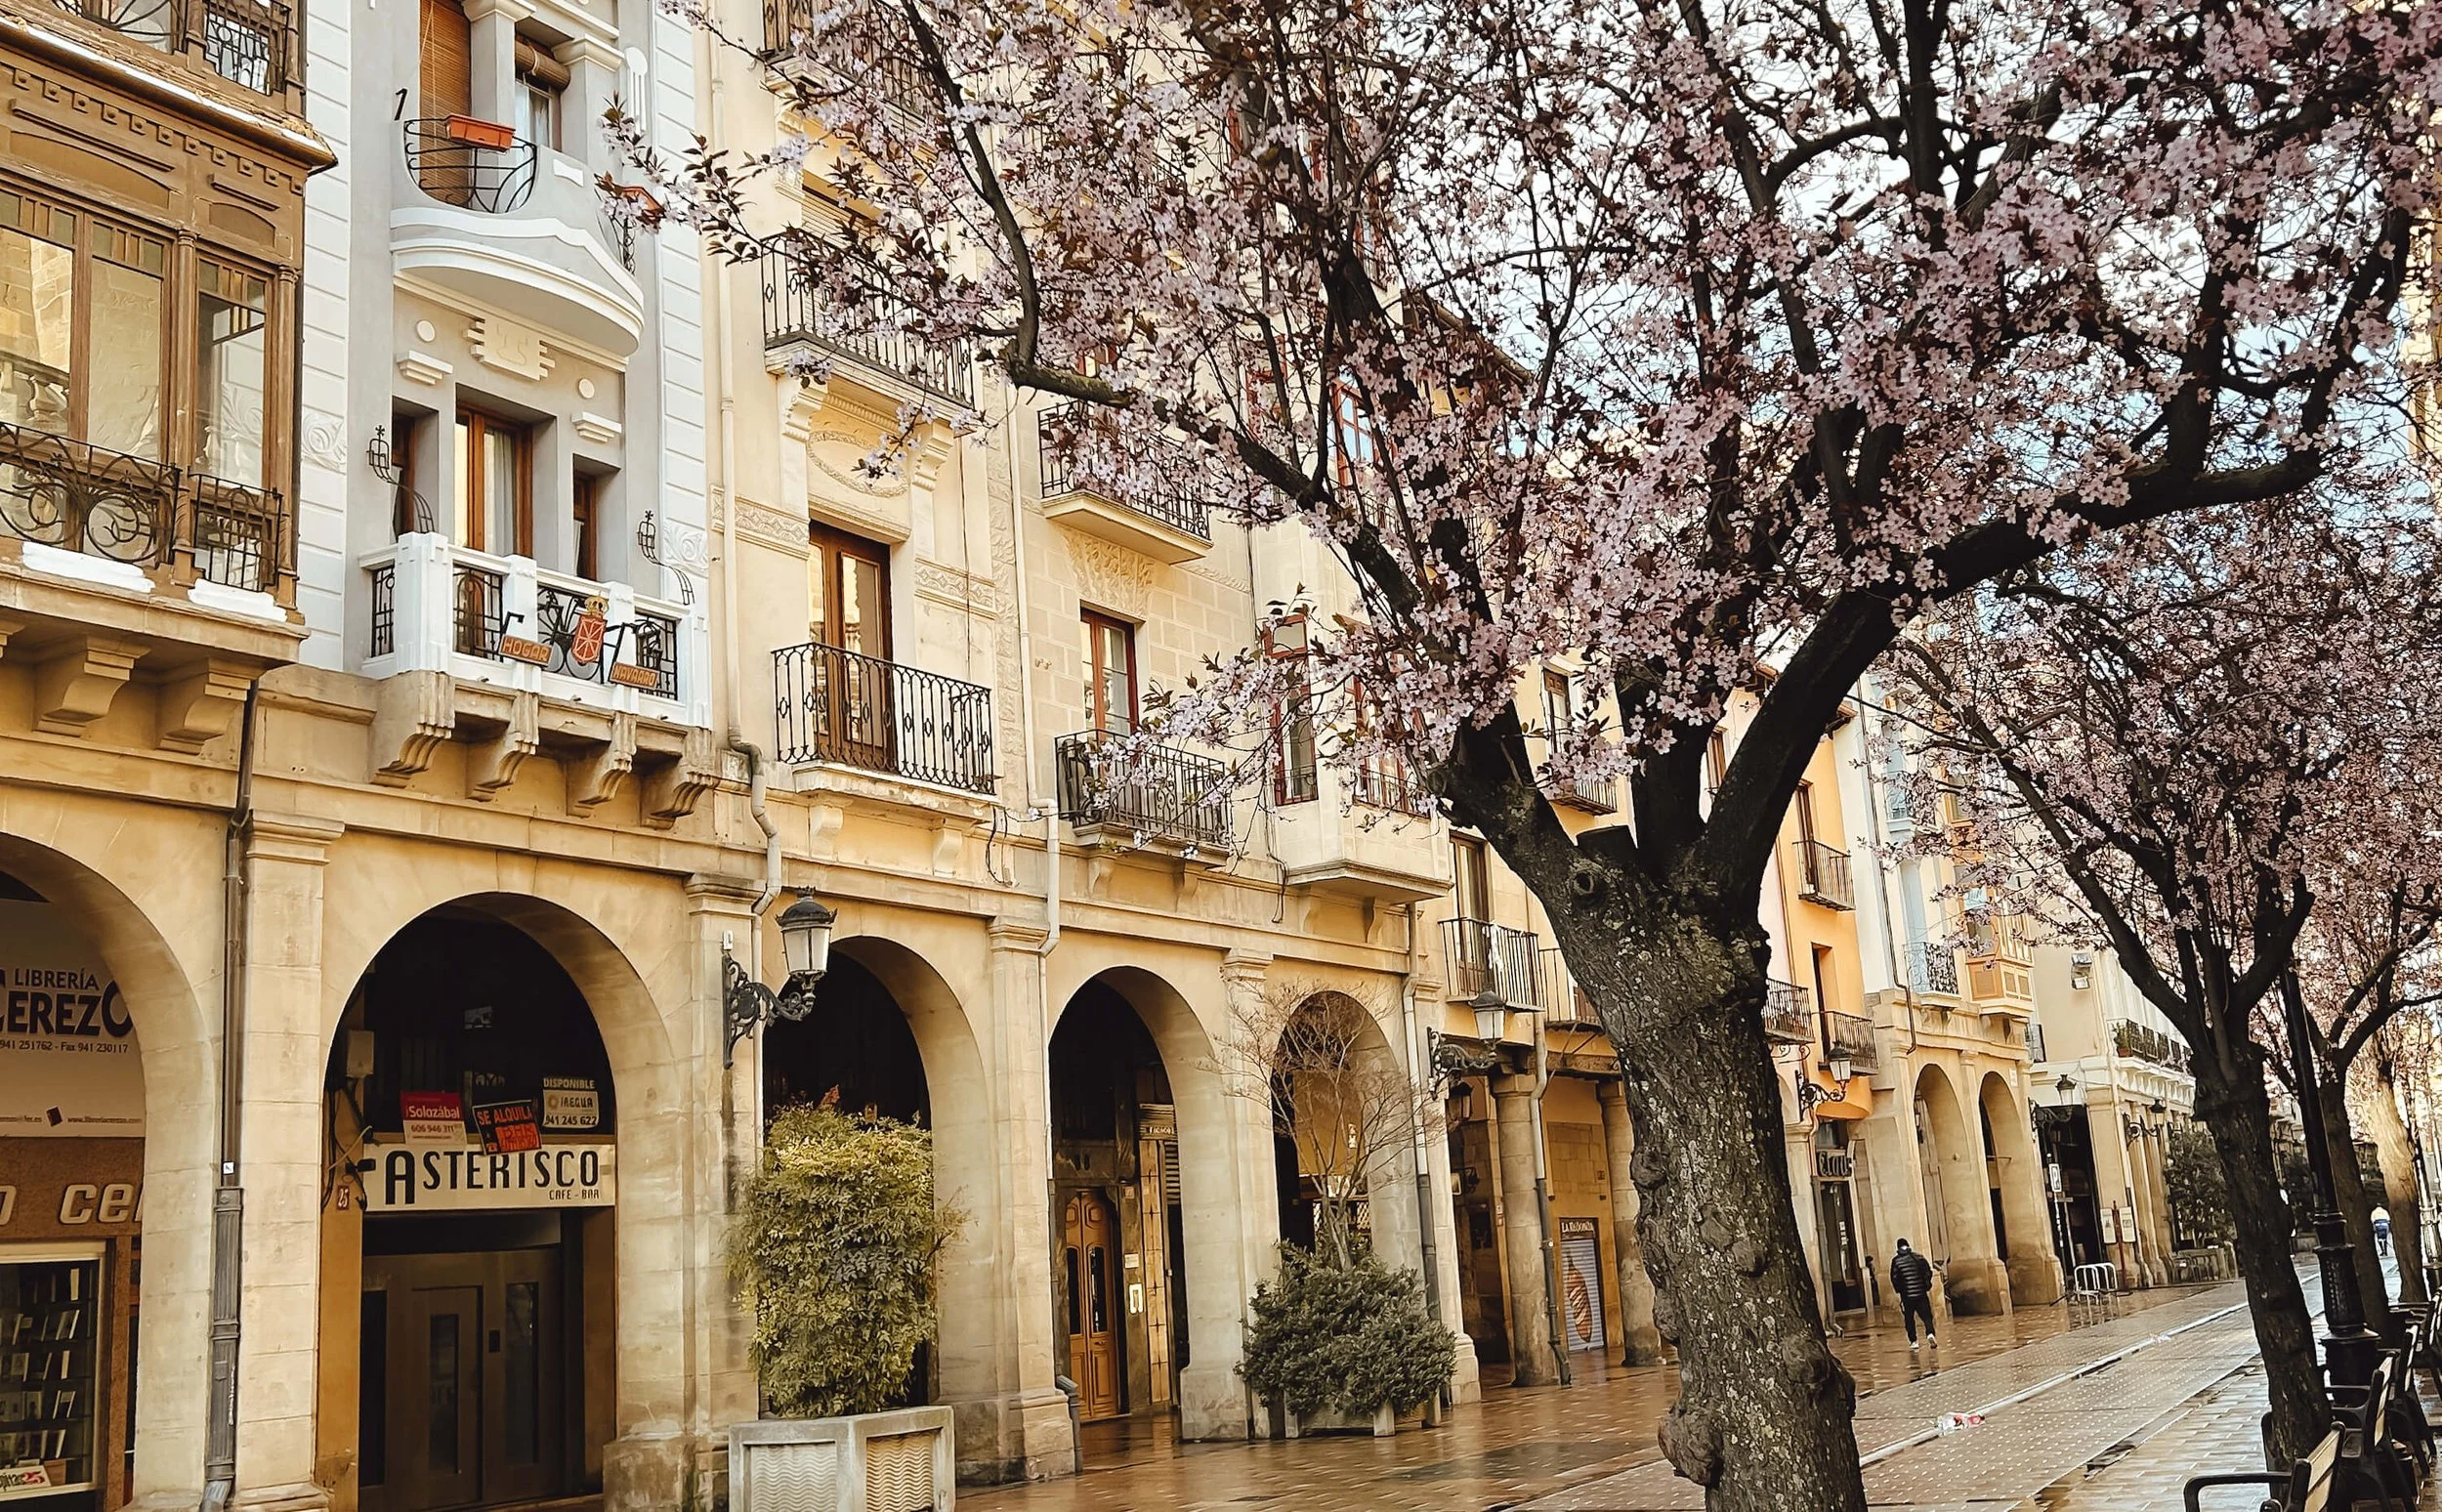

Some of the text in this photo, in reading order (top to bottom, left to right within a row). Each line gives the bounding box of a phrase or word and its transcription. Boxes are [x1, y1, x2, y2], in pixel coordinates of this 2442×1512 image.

[502, 636, 549, 661] HOGAR
[613, 664, 655, 686] NAVARRO
[15, 968, 99, 990] LIBRERÍA
[0, 980, 134, 1037] EREZO
[19, 1040, 52, 1051] 251762
[61, 1042, 74, 1052] Fax
[78, 1042, 93, 1052] 941
[97, 1043, 128, 1053] 230117
[543, 1077, 595, 1090] DISPONIBLE
[477, 1110, 492, 1126] SE
[562, 1115, 578, 1126] 245
[579, 1115, 598, 1126] 622
[385, 1150, 600, 1206] ASTERISCO
[60, 1183, 144, 1224] ce
[549, 1189, 571, 1200] CAFE
[581, 1188, 599, 1200] BAR
